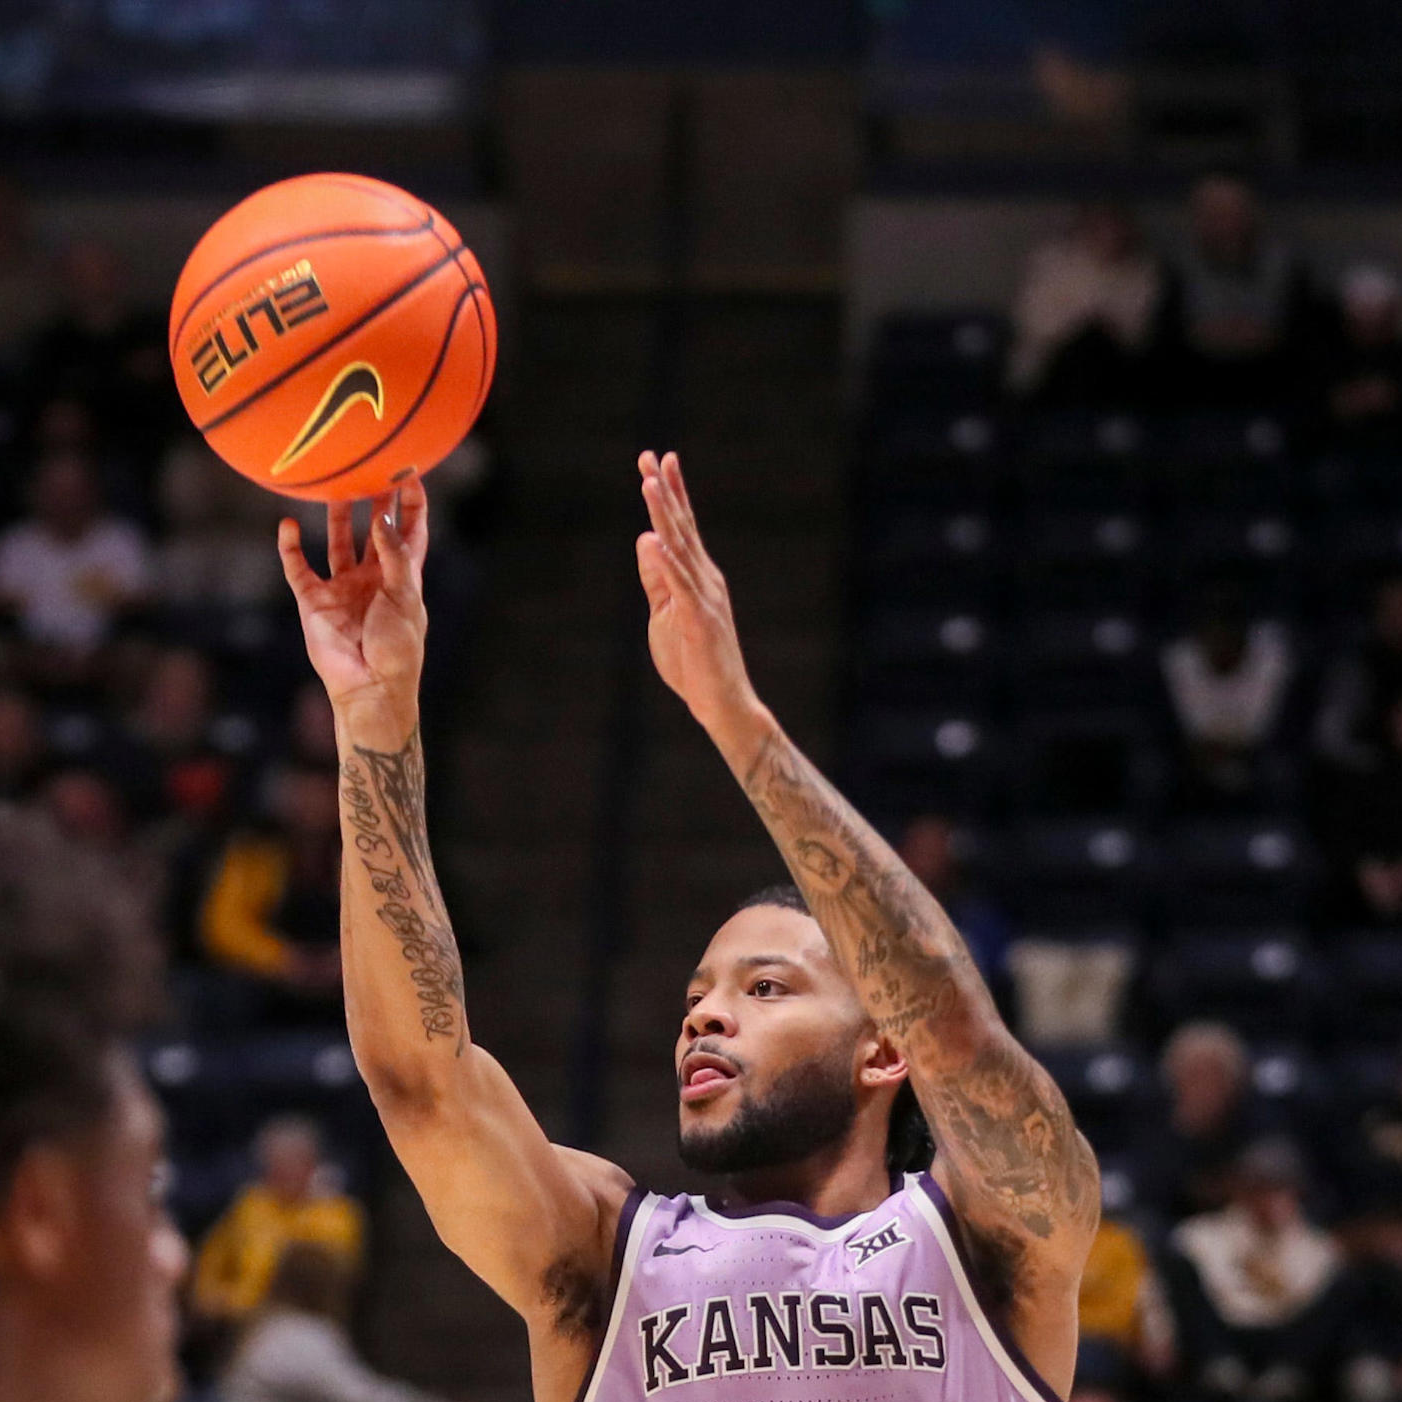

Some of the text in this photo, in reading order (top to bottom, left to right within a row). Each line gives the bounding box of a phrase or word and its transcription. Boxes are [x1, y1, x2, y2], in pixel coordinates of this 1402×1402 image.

[190, 275, 331, 398] ELITE
[846, 1218, 910, 1267] XII
[638, 1291, 948, 1398] KANSAS
